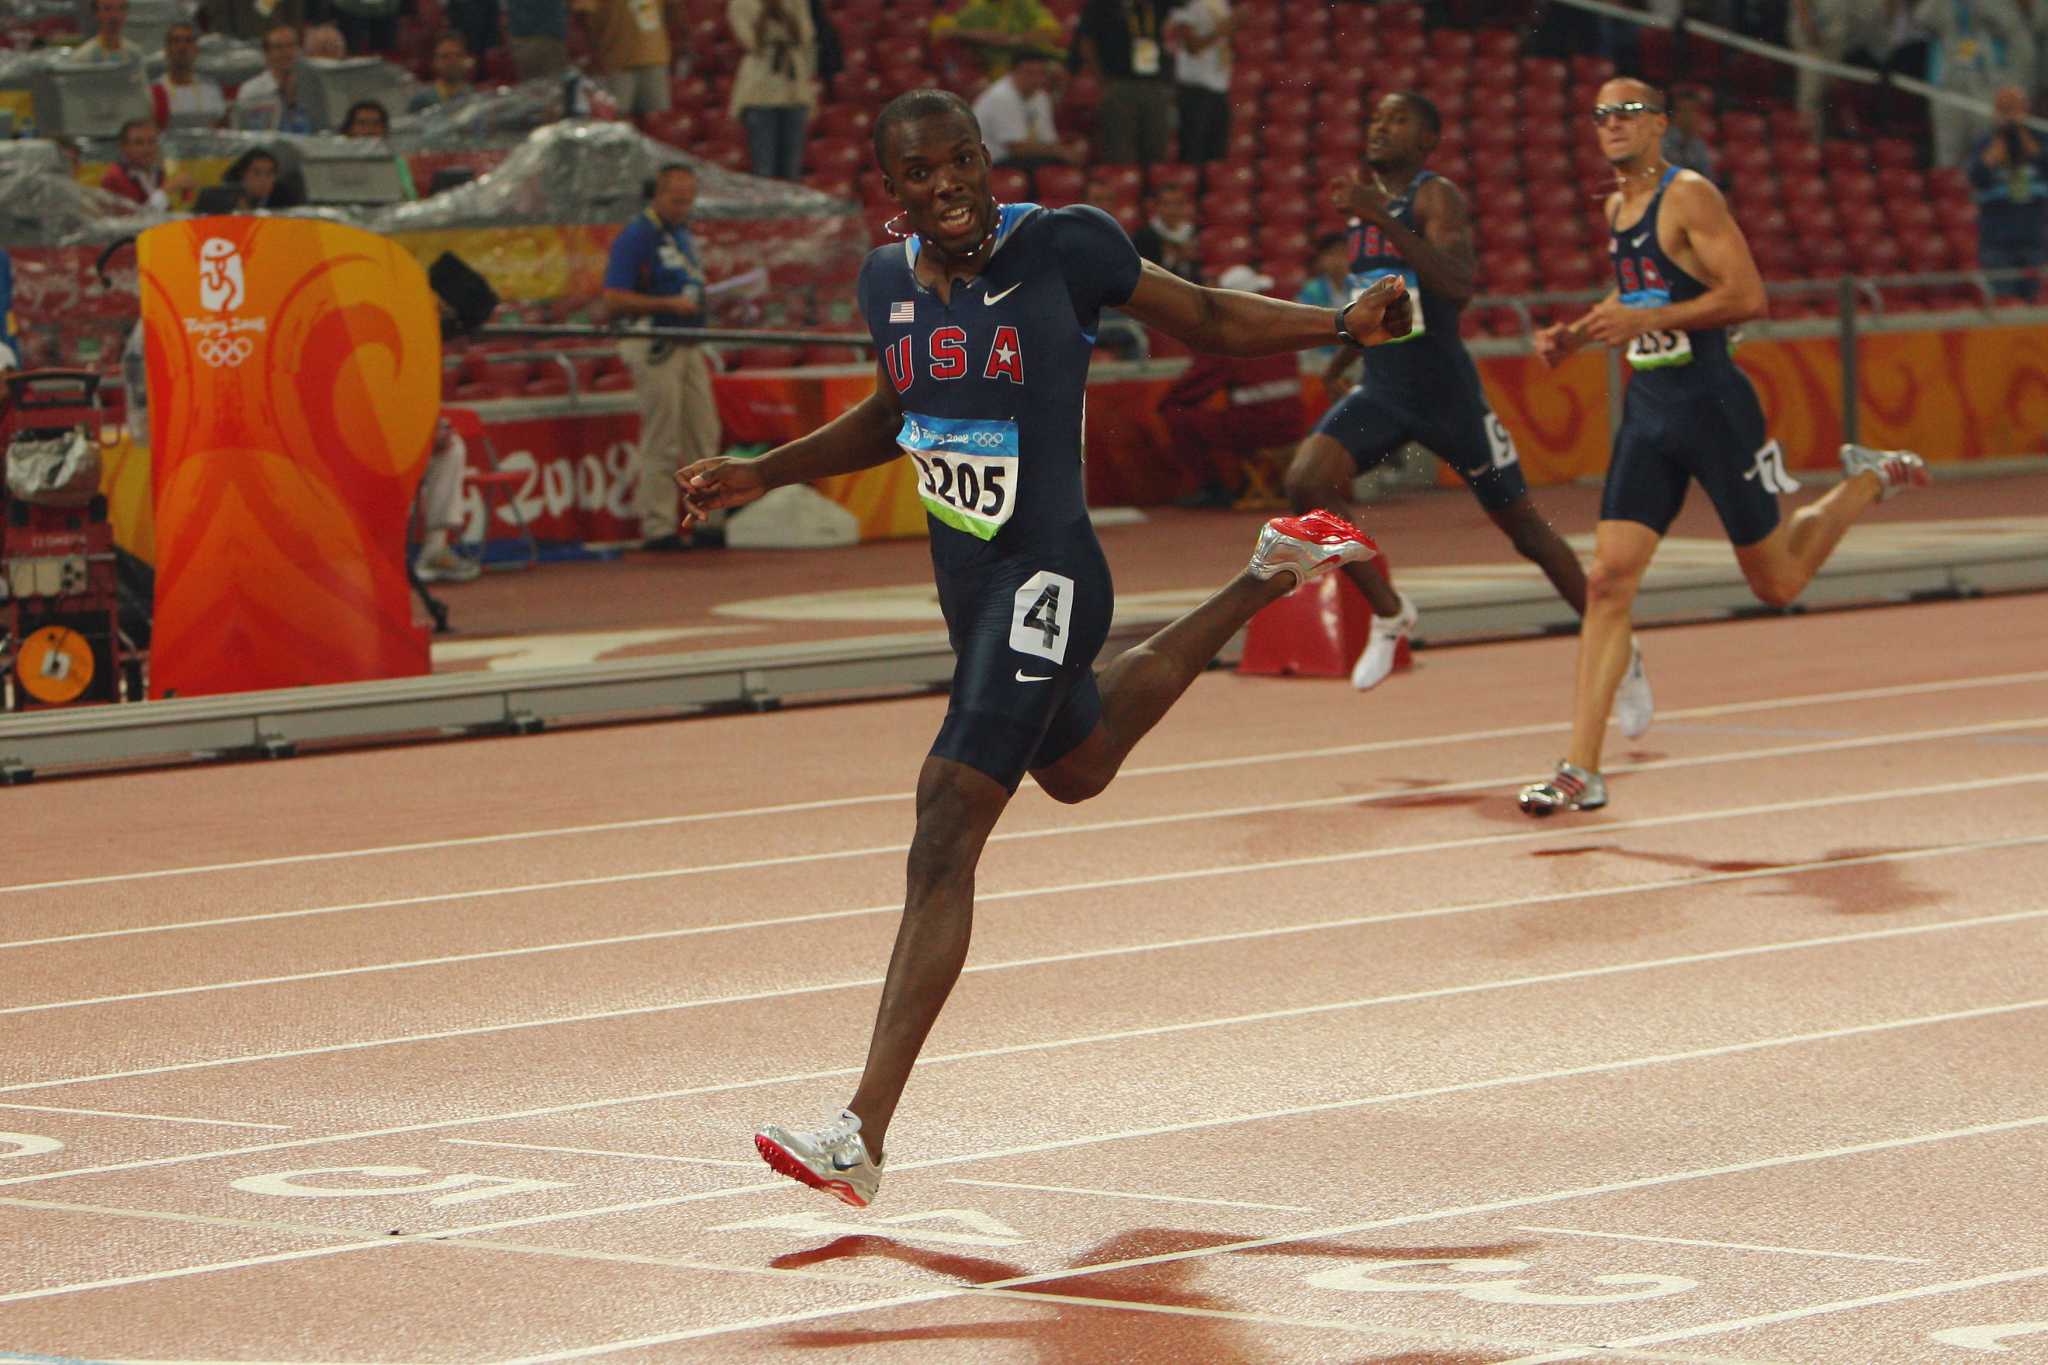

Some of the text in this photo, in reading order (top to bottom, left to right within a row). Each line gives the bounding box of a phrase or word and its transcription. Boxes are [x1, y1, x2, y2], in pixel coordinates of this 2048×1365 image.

[884, 325, 1024, 394] USA
[920, 428, 970, 445] Beijing 2008
[496, 441, 642, 526] 2008
[1023, 583, 1060, 649] 4
